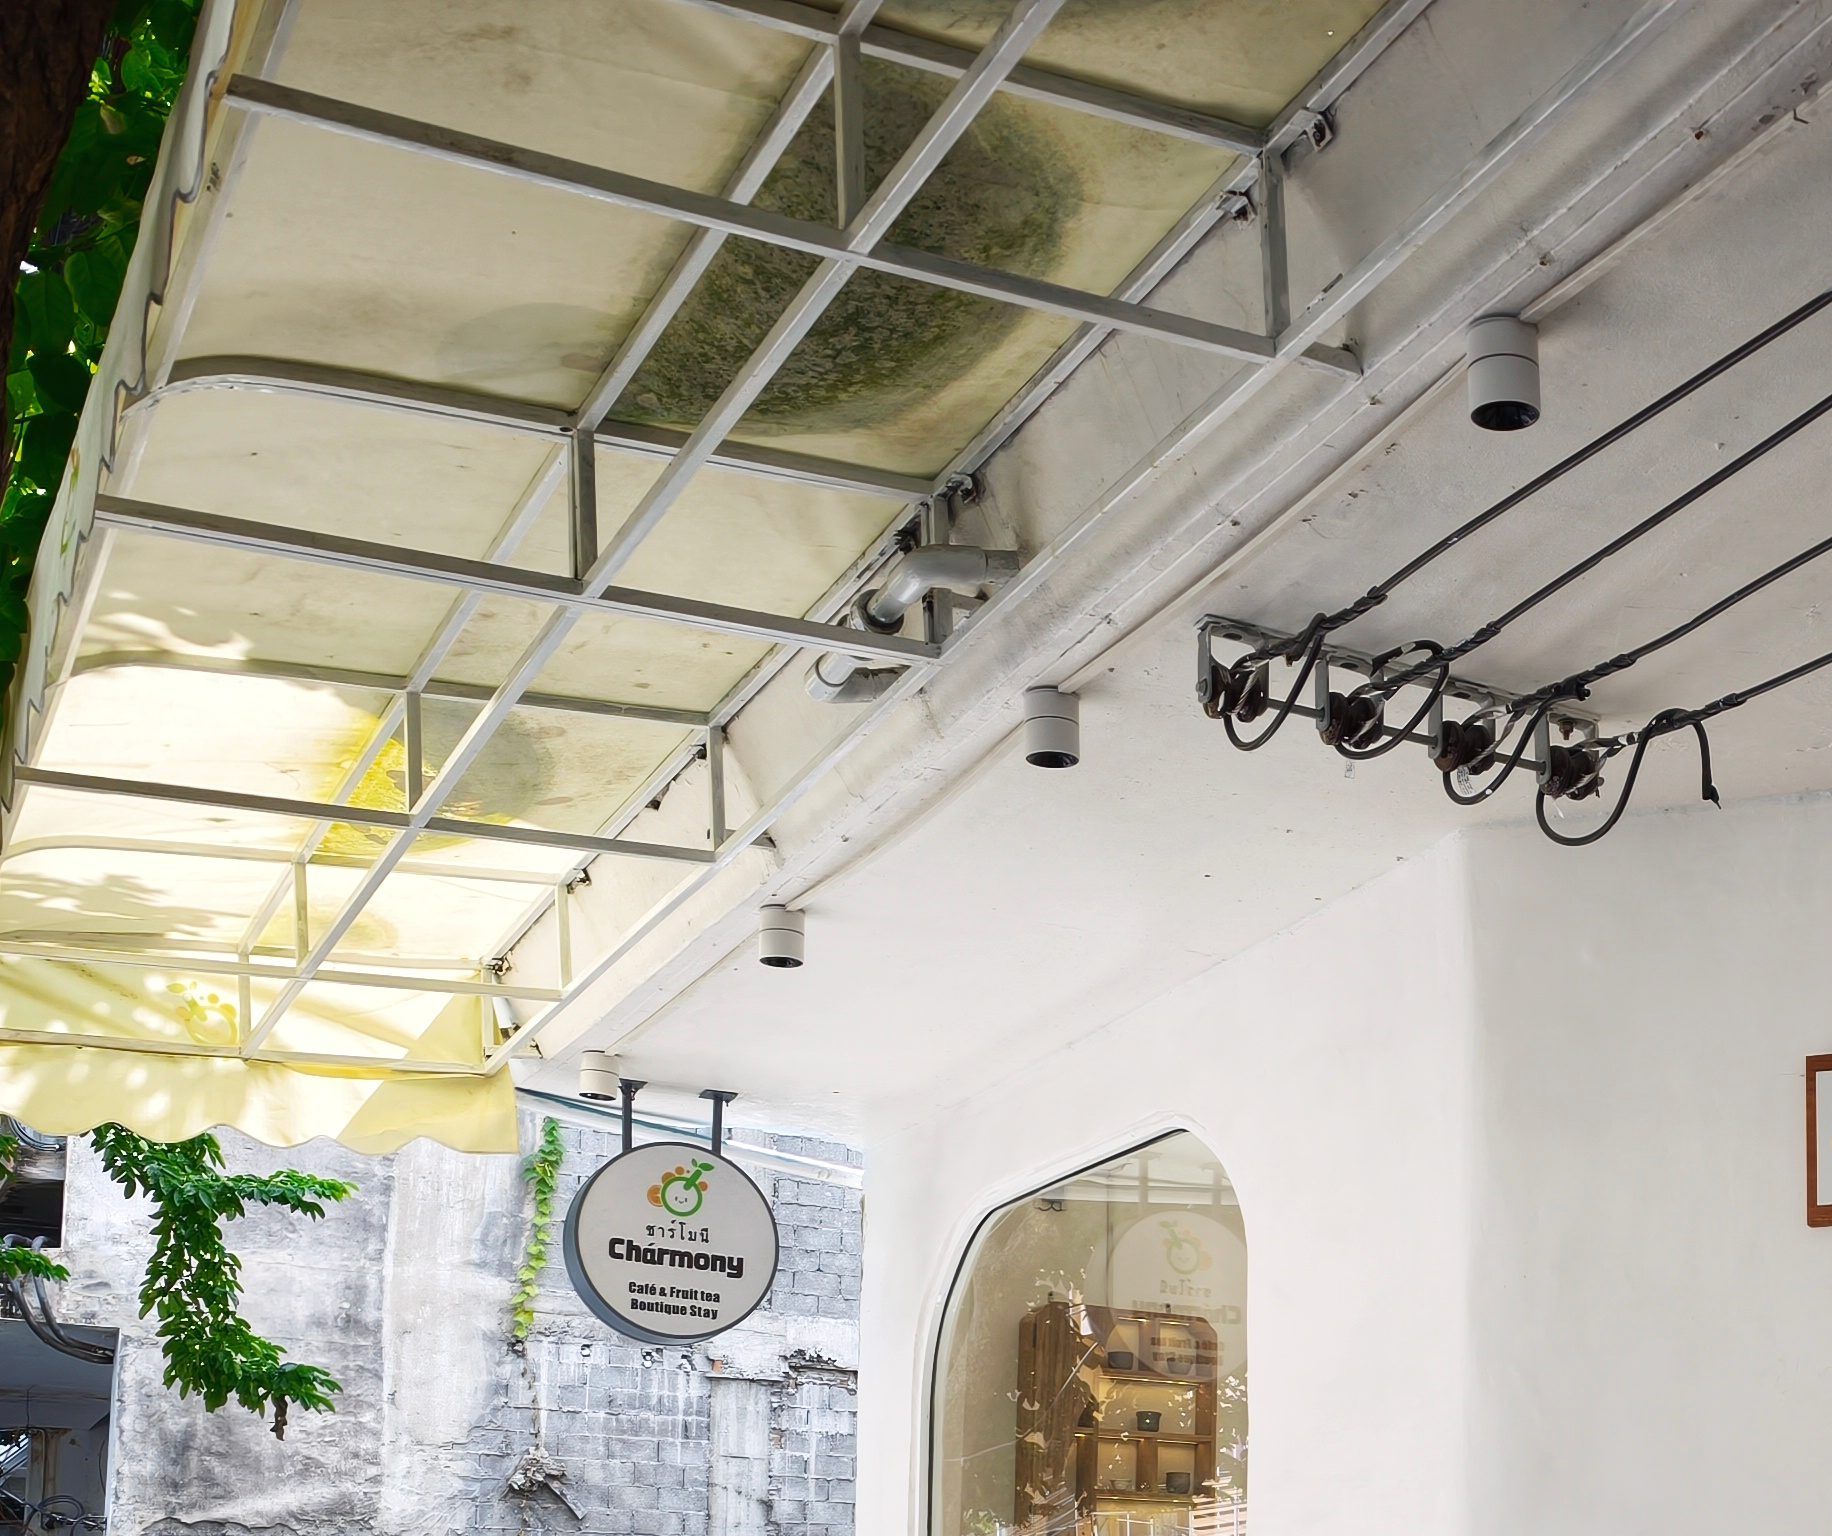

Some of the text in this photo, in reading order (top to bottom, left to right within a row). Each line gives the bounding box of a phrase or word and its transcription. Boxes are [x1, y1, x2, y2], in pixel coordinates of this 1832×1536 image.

[645, 1219, 710, 1244] ชาร์โมนี
[608, 1237, 744, 1279] Chármony
[628, 1281, 720, 1303] Café & Fruit tea
[630, 1298, 719, 1320] Boutique Stay
